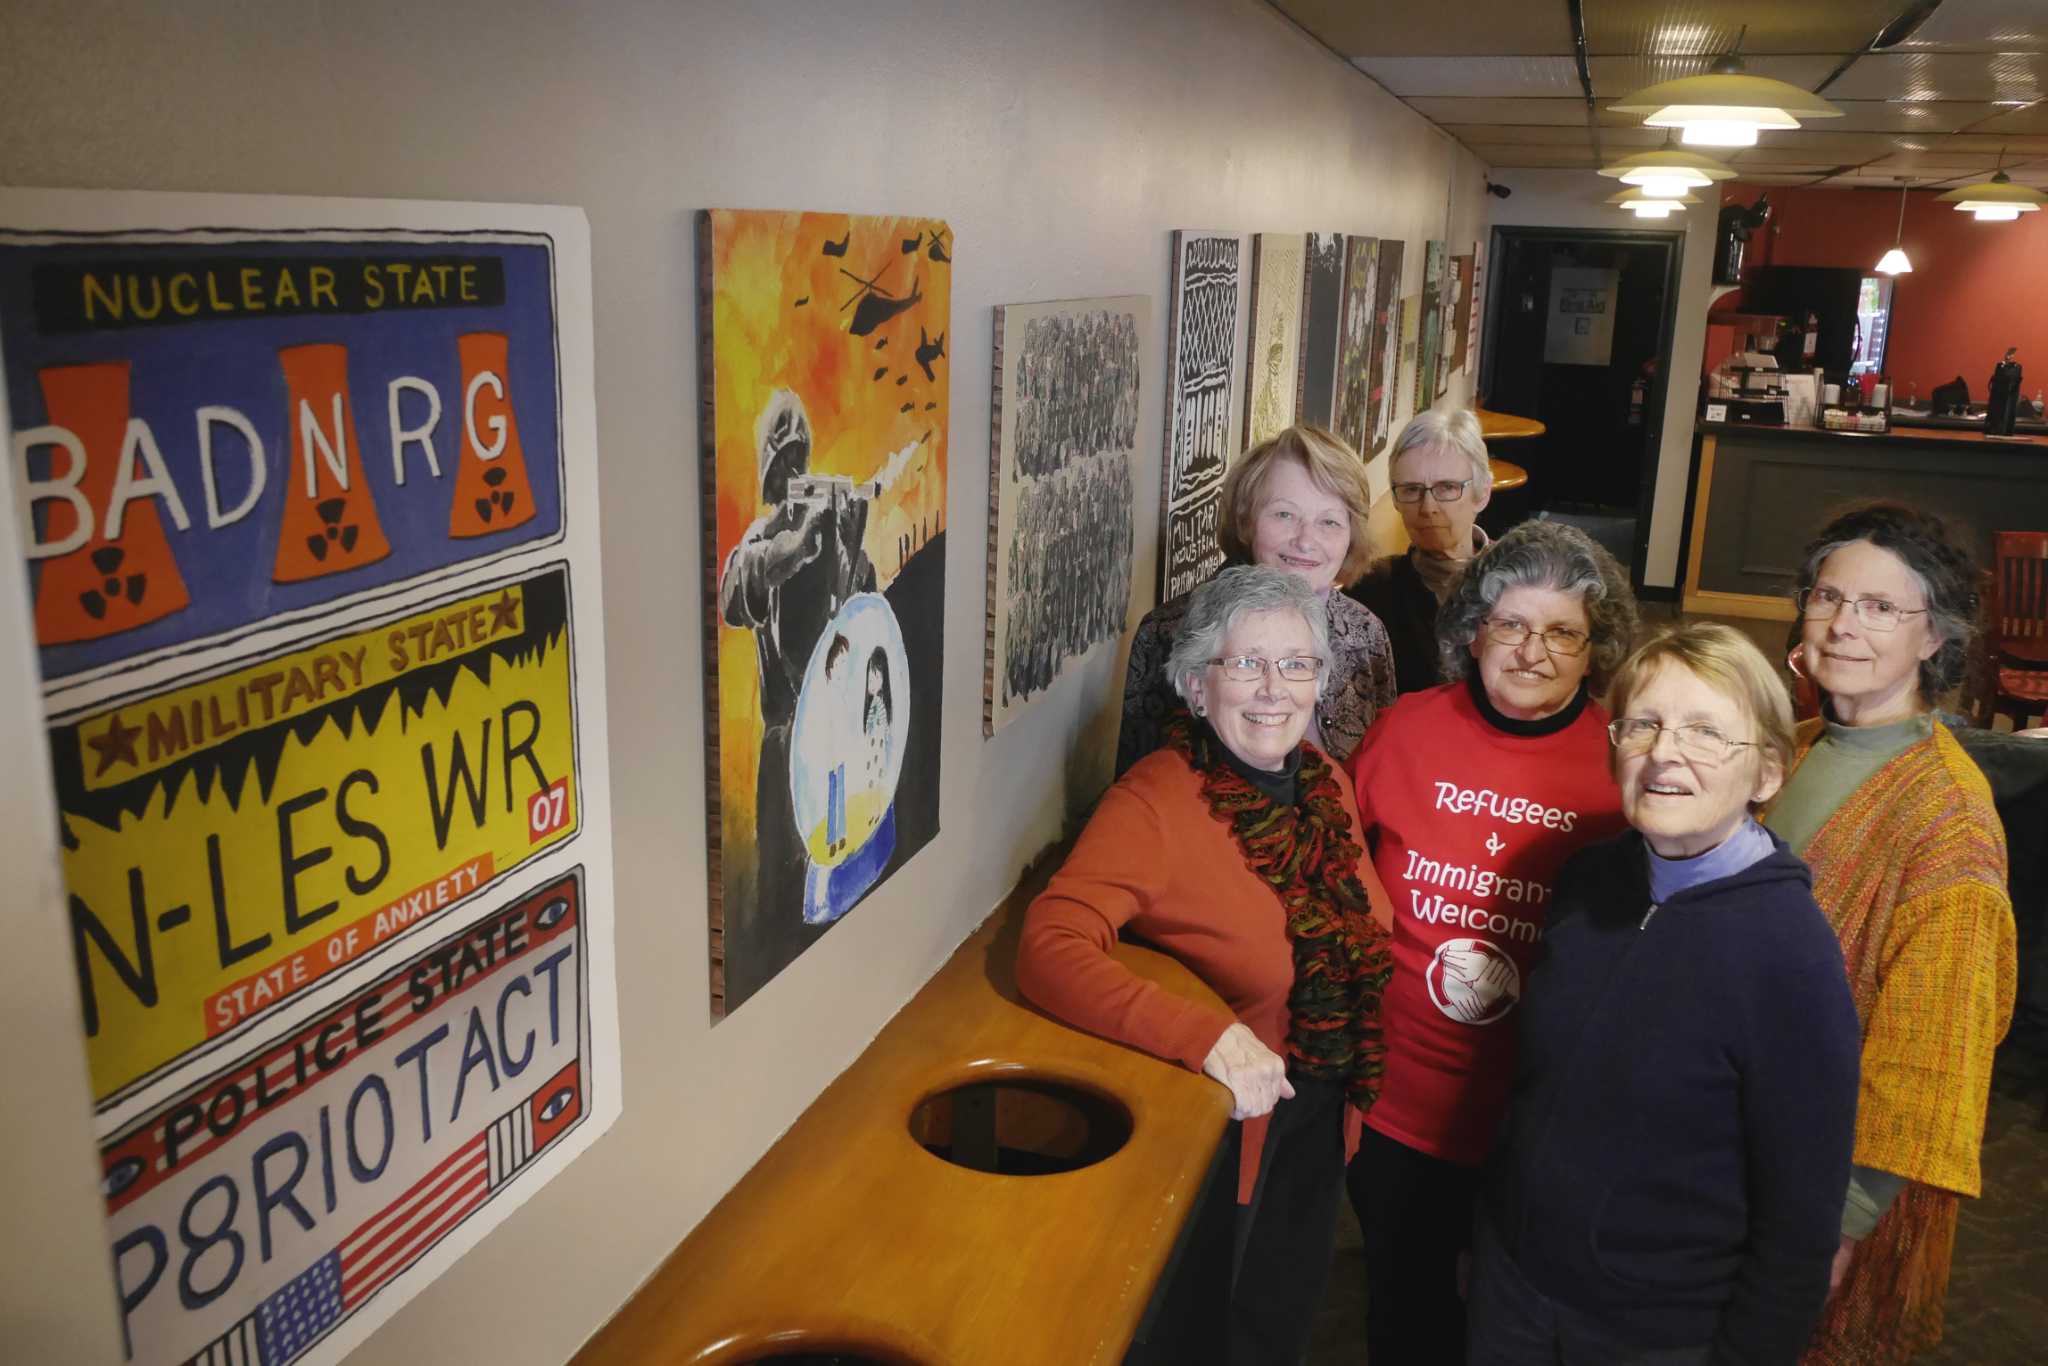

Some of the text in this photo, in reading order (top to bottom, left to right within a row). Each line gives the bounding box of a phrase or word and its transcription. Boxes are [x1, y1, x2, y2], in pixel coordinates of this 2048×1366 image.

[81, 263, 479, 321] NUCLEAR STATE
[1173, 497, 1221, 549] MILITARY
[147, 605, 488, 764] MILITARY STATE
[420, 700, 551, 851] WR
[530, 787, 567, 833] 07
[1434, 781, 1577, 833] Refugees
[1485, 832, 1506, 857] &
[1402, 850, 1552, 904] Immigran
[1410, 889, 1543, 943] Welcom
[214, 862, 481, 1029] STATE OF ANXIETY
[163, 910, 529, 1169] POLICE STATE
